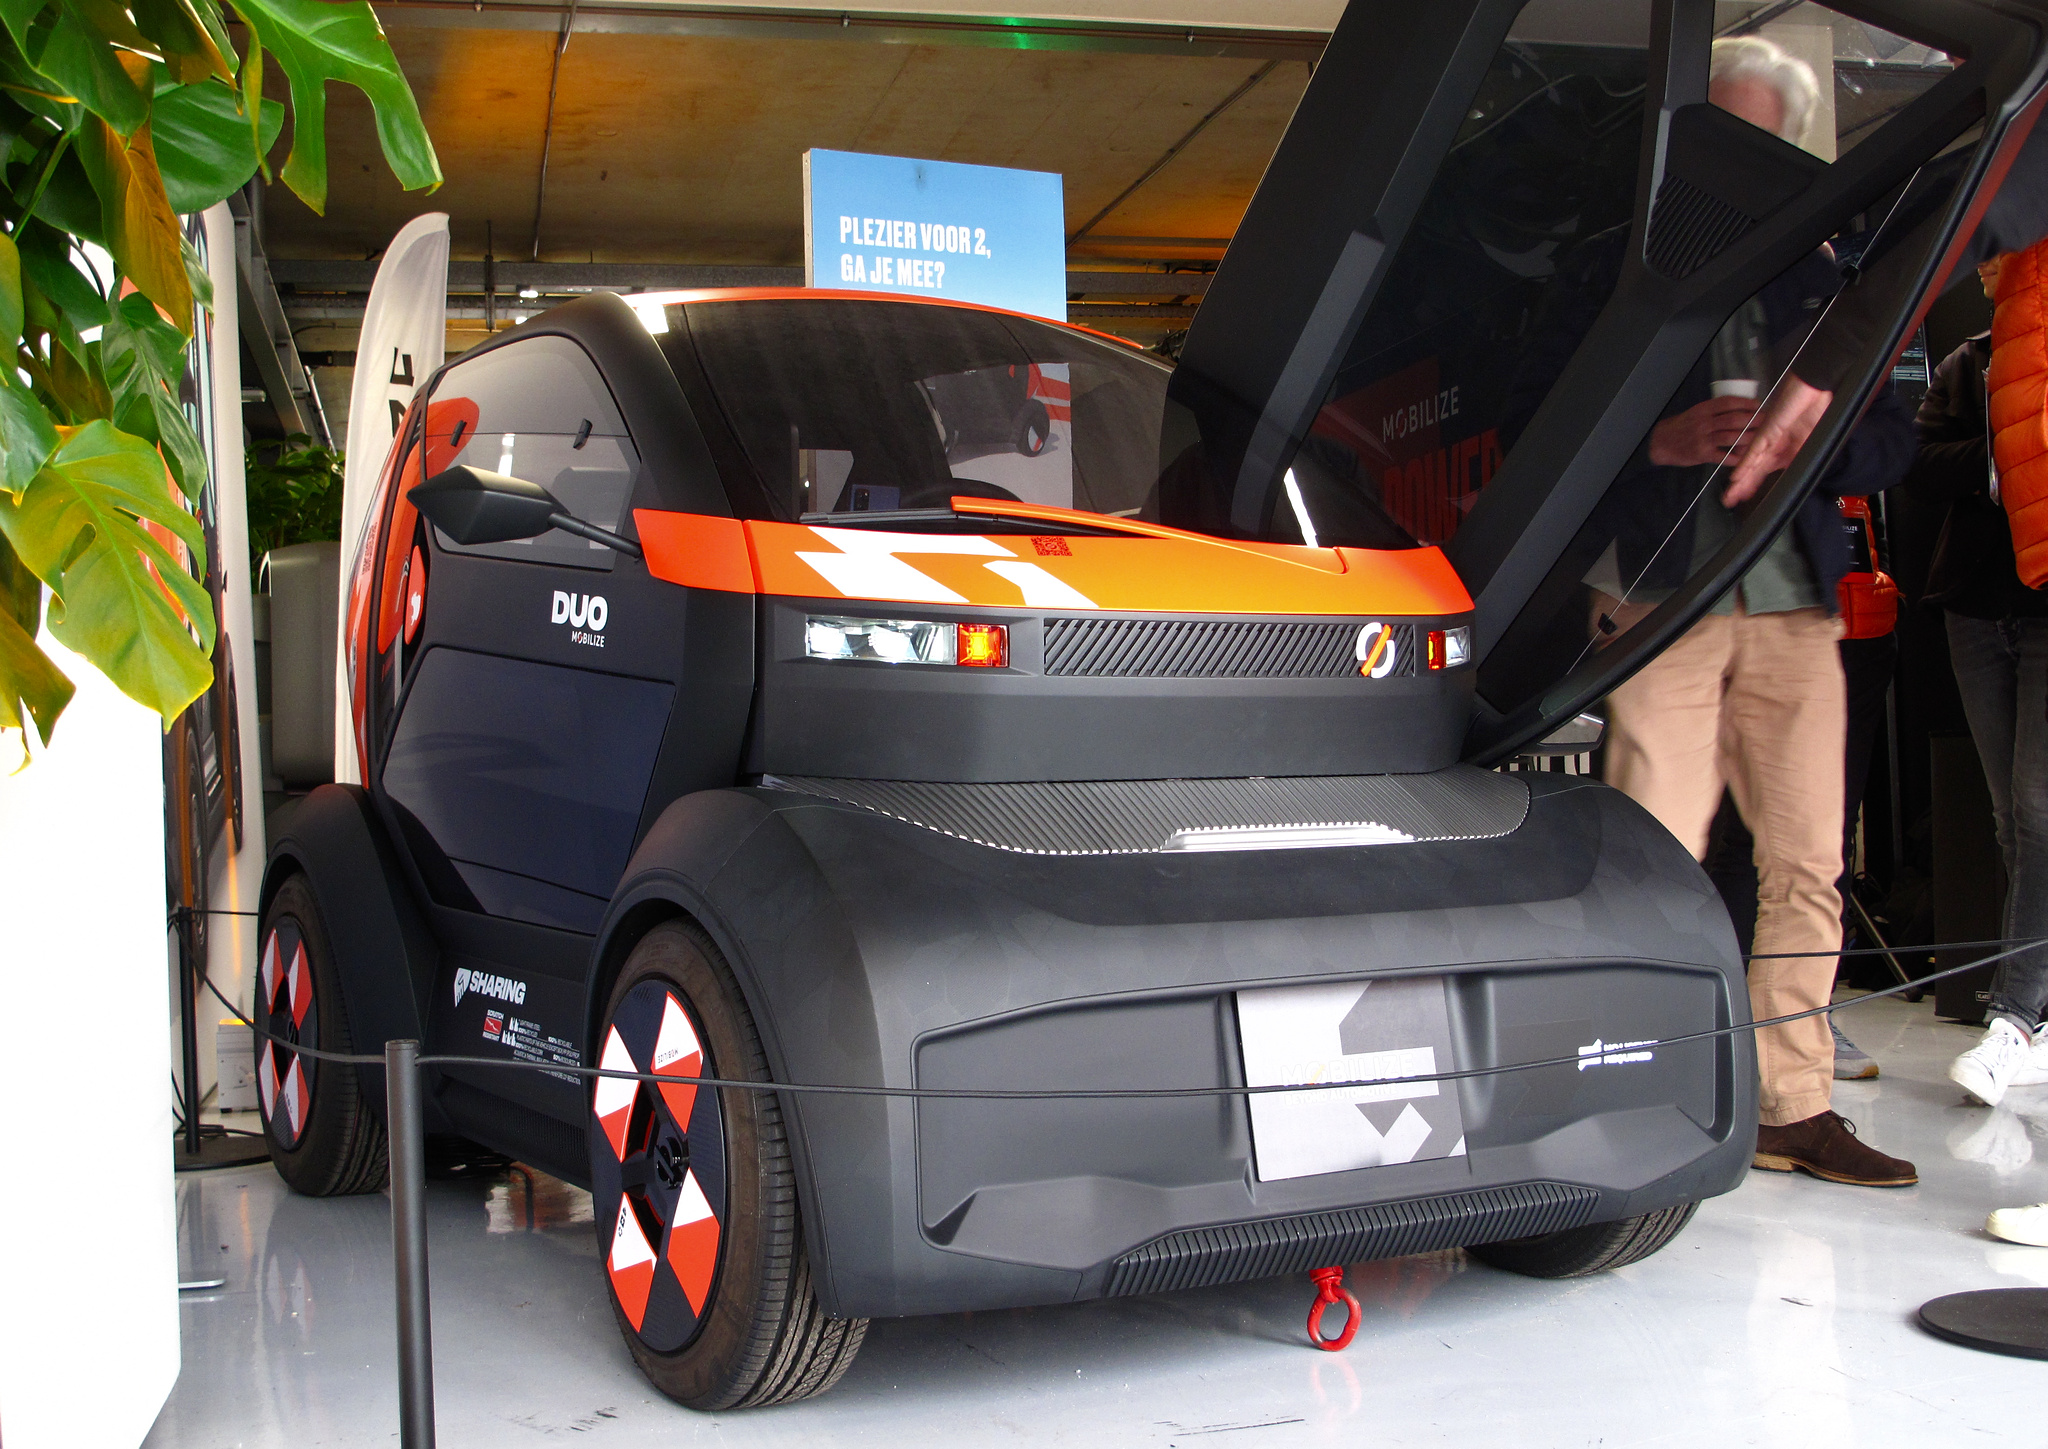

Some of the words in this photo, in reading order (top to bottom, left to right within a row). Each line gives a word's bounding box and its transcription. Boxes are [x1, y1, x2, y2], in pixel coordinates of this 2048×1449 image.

[840, 216, 917, 250] PLEZIER
[919, 223, 971, 254] VOOR
[974, 227, 992, 259] 2,
[841, 254, 866, 283] GA
[870, 257, 893, 285] JE
[897, 258, 945, 289] MEE?
[1383, 386, 1459, 443] MOBILIZE
[551, 590, 608, 631] DUO
[571, 631, 605, 648] MOBILIZE
[469, 970, 526, 1005] SHARING
[1280, 1053, 1415, 1086] MOBILIZE
[1284, 1091, 1328, 1106] BEYOND
[1330, 1084, 1398, 1101] AUTOMOTIVE
